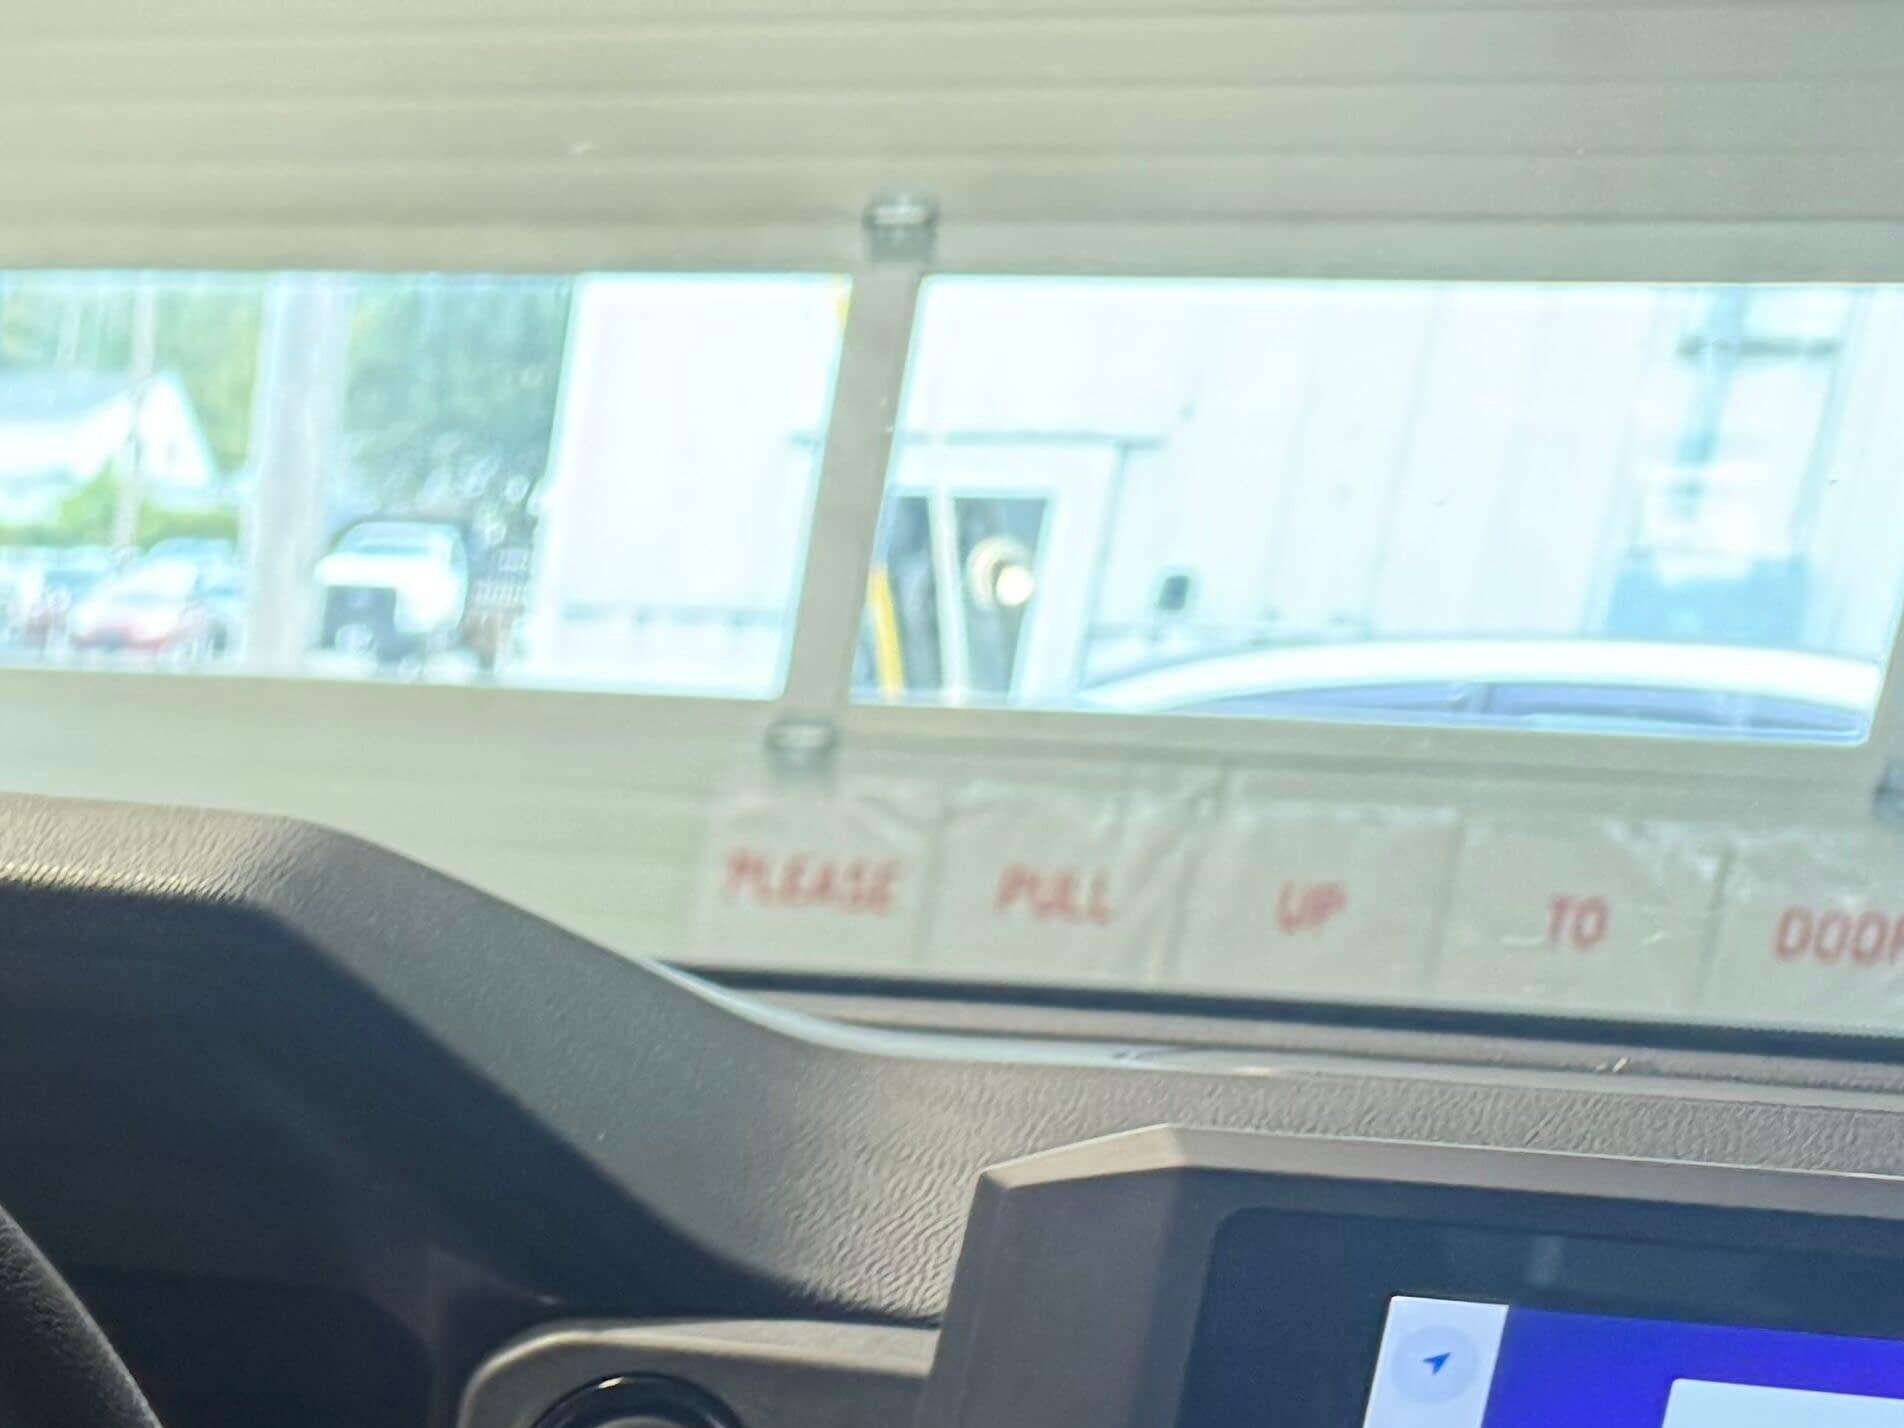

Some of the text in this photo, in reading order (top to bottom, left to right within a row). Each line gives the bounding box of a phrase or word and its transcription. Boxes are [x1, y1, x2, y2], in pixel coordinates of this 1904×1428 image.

[725, 848, 900, 916] PLEASE
[994, 862, 1112, 926] PULL
[1275, 881, 1347, 936] UP
[1547, 893, 1611, 951] TO
